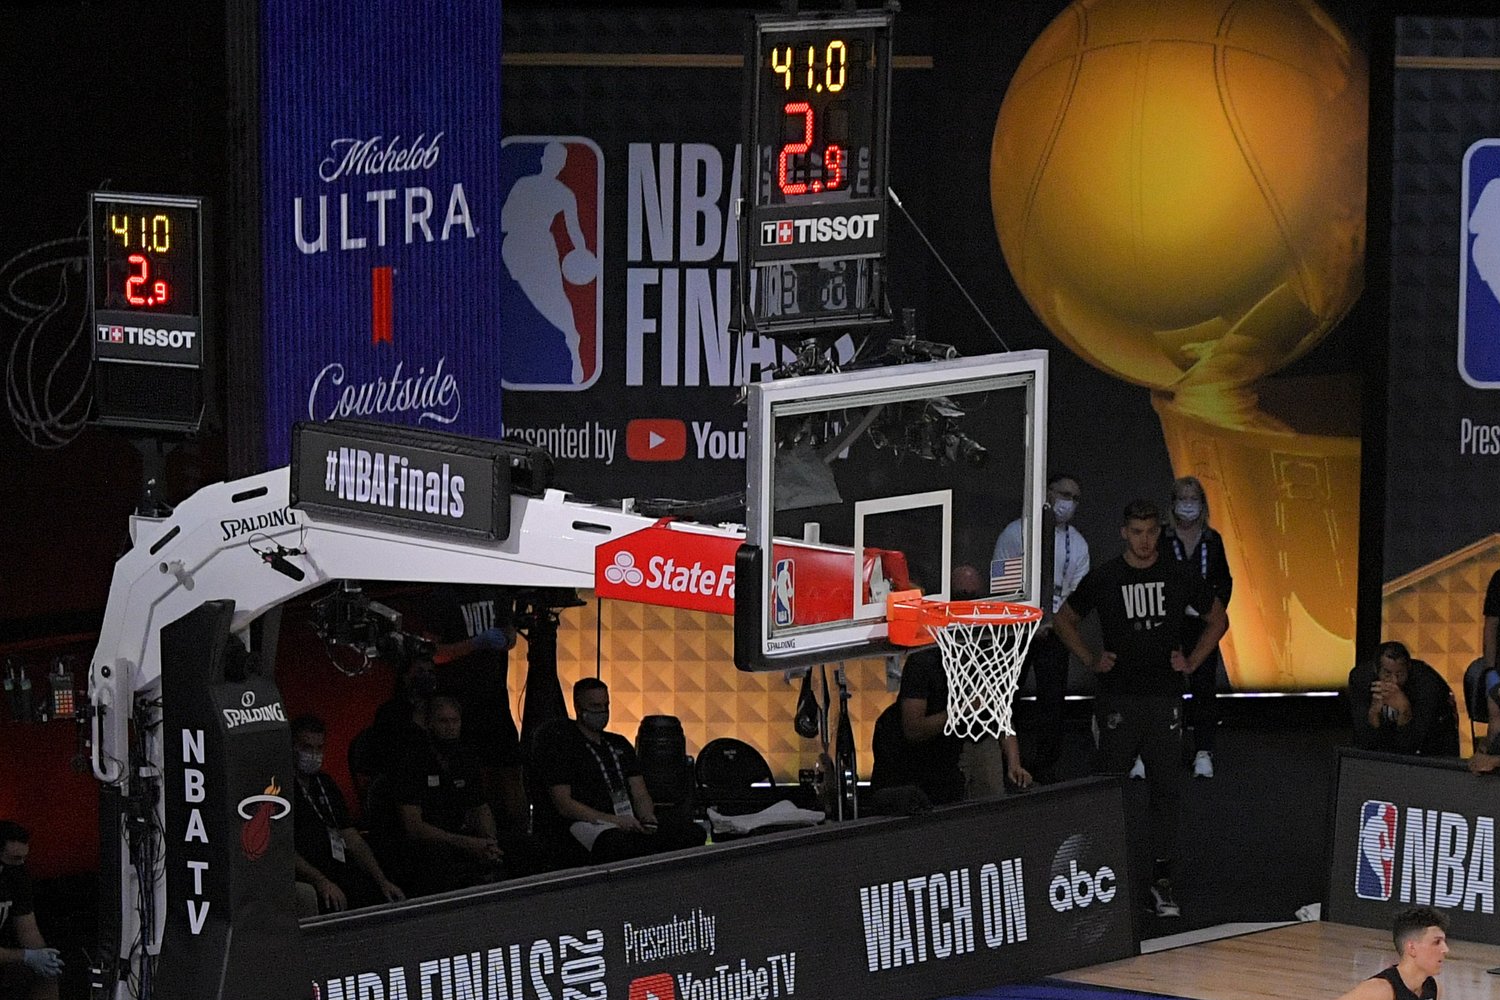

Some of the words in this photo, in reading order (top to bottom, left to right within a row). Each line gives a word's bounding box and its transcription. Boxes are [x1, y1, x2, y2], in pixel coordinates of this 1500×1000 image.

[772, 40, 846, 92] 41.0
[319, 131, 444, 182] Michelob
[779, 102, 841, 194] 2.9
[112, 214, 169, 252] 41.0
[294, 183, 475, 254] ULTRA
[795, 214, 879, 243] TISSOT
[126, 254, 167, 305] 2.9
[125, 327, 195, 348] TISSOT
[309, 358, 460, 424] Courtside
[594, 422, 617, 465] by
[325, 447, 465, 519] #NBAFinals
[220, 505, 297, 542] SPALDING
[461, 600, 496, 638] VOTE
[1121, 582, 1167, 619] VOTE
[767, 639, 796, 652] SPALDING
[223, 702, 287, 729] SPALDING
[182, 728, 209, 843] NBA
[1400, 808, 1495, 914] NBA
[187, 861, 210, 934] TV
[860, 867, 975, 972] WATCH
[980, 857, 1028, 950] ON
[1049, 859, 1117, 913] abc
[624, 910, 698, 965] Presented
[699, 908, 717, 957] by
